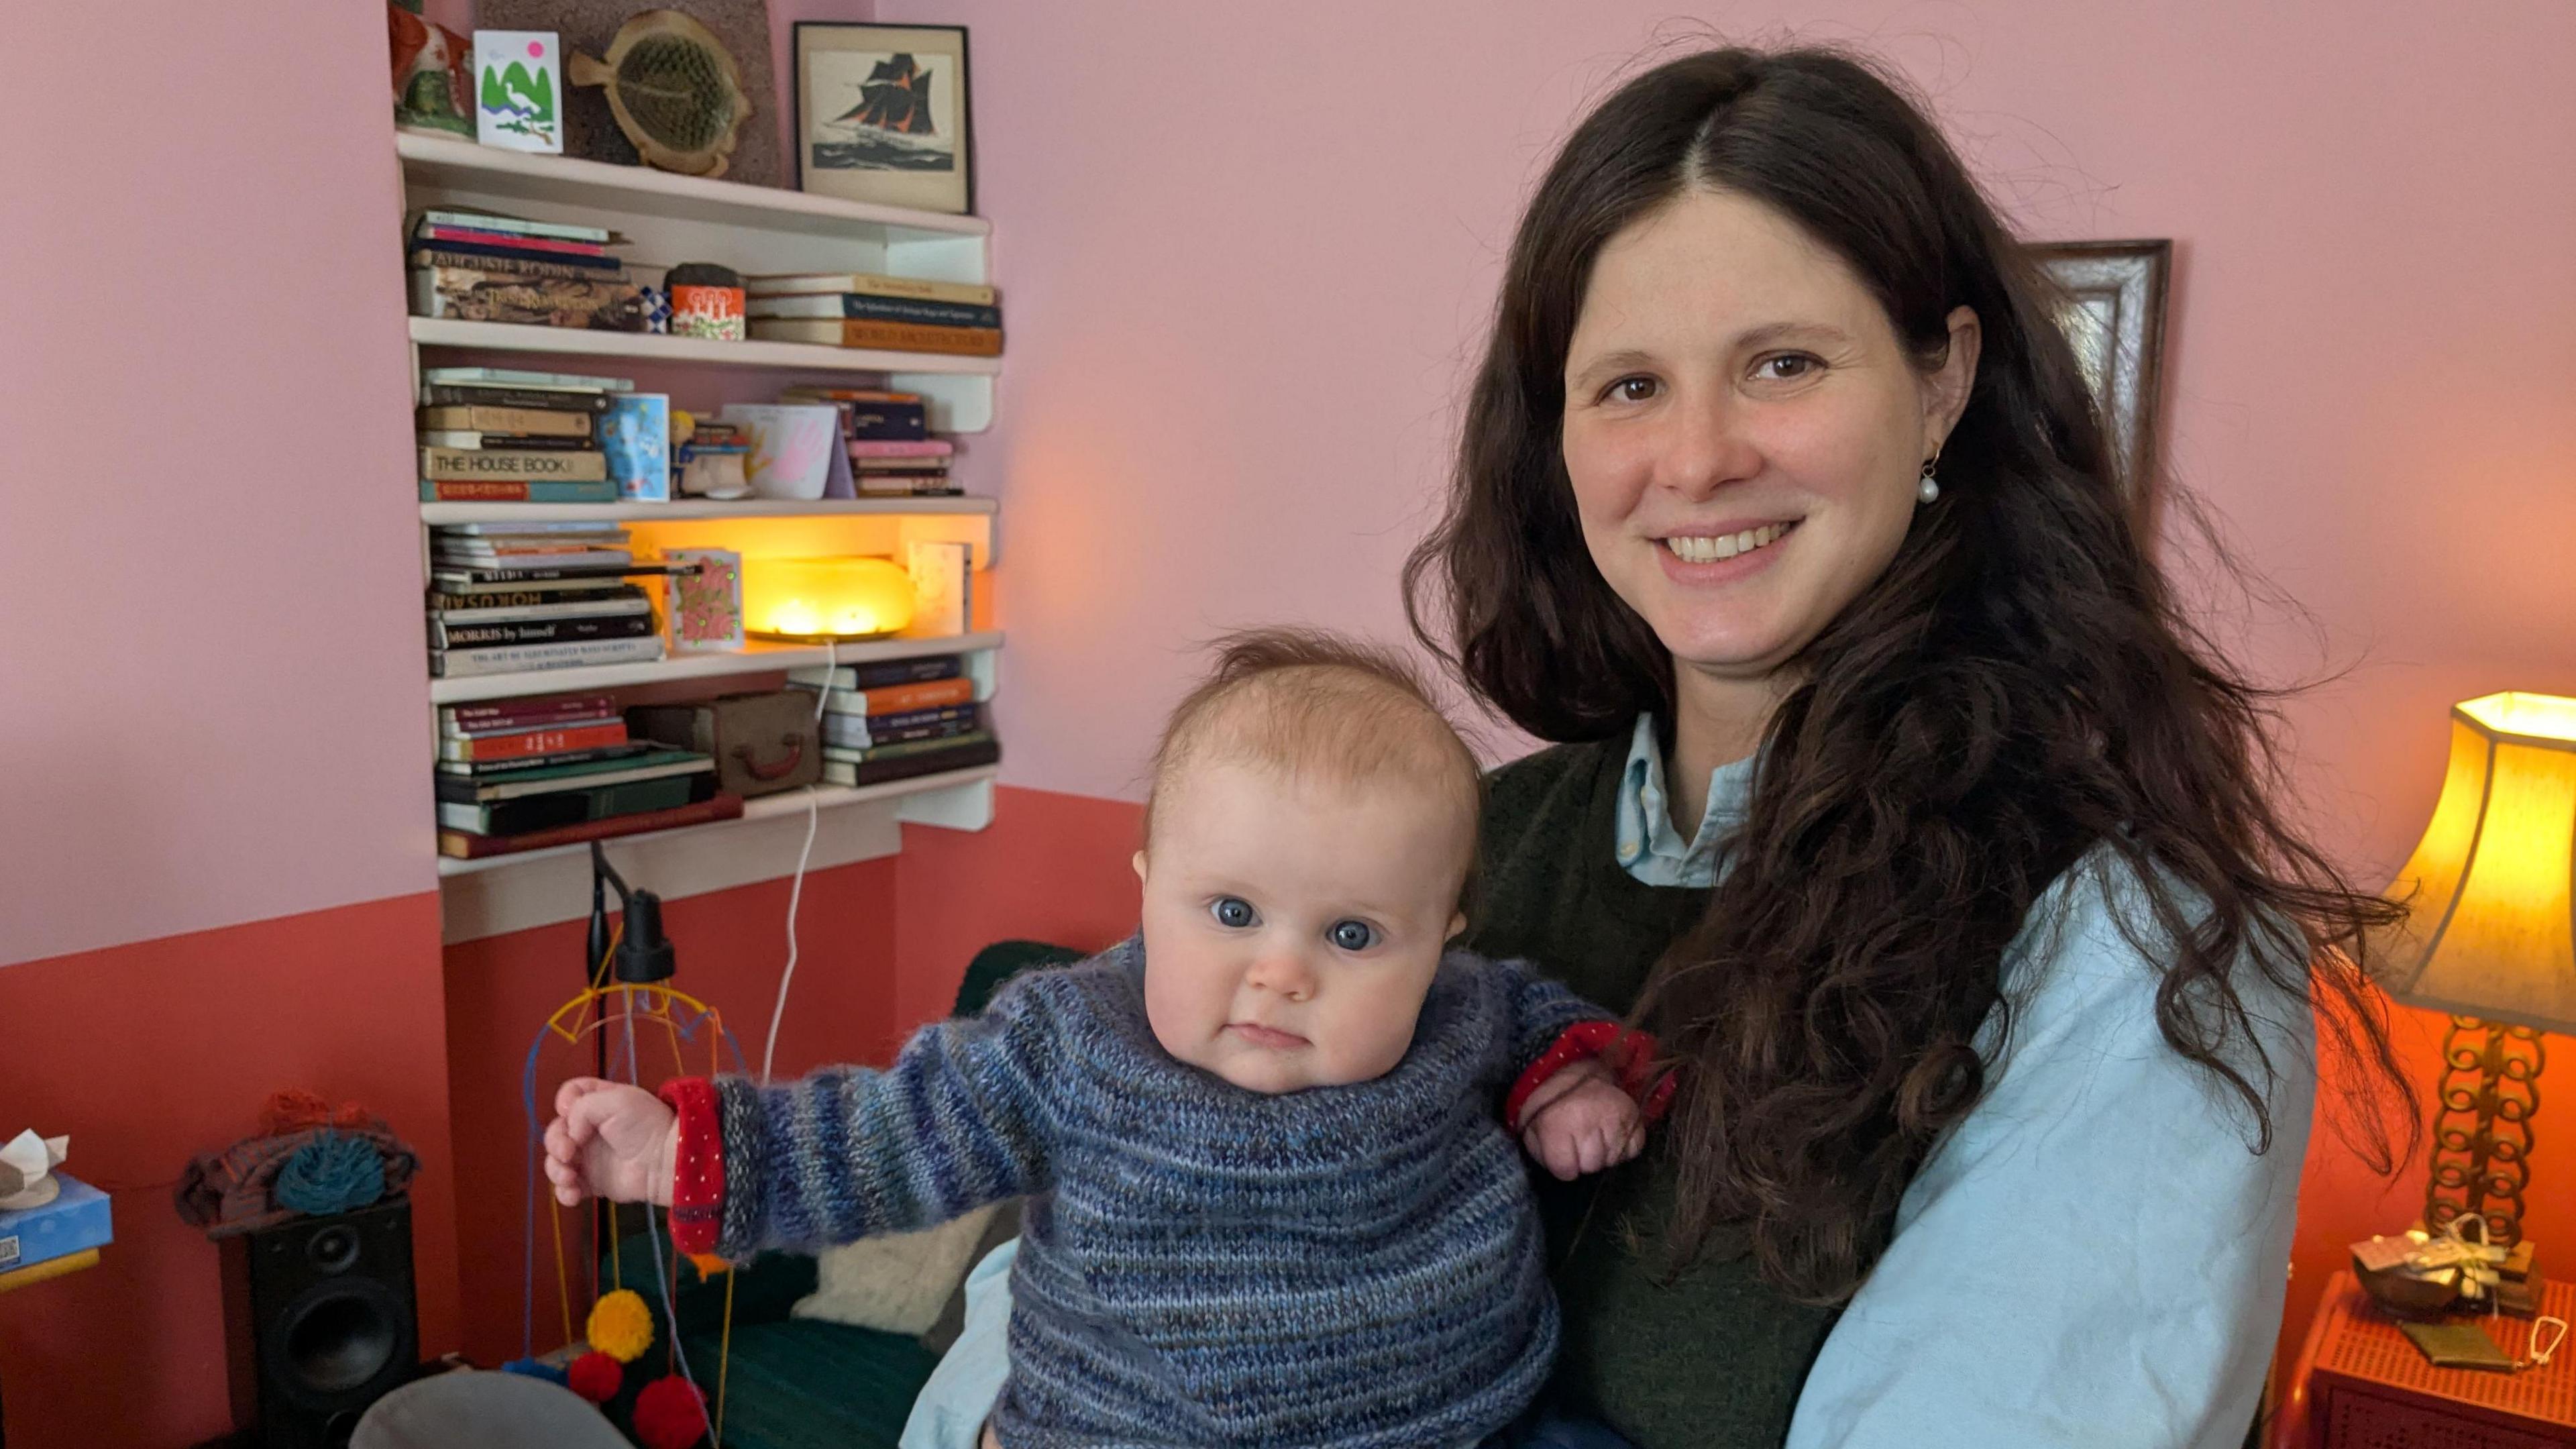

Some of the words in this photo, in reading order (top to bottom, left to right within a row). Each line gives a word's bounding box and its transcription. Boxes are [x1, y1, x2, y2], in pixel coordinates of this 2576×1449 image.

[436, 253, 513, 271] AUGUSTE
[519, 260, 575, 277] RODIN
[437, 457, 466, 472] THE
[470, 457, 520, 472] HOUSE
[524, 457, 566, 472] BOOK
[446, 591, 542, 610] HOKUSAI
[447, 628, 502, 643] MORRIS
[504, 627, 516, 641] by
[519, 623, 557, 638] himself
